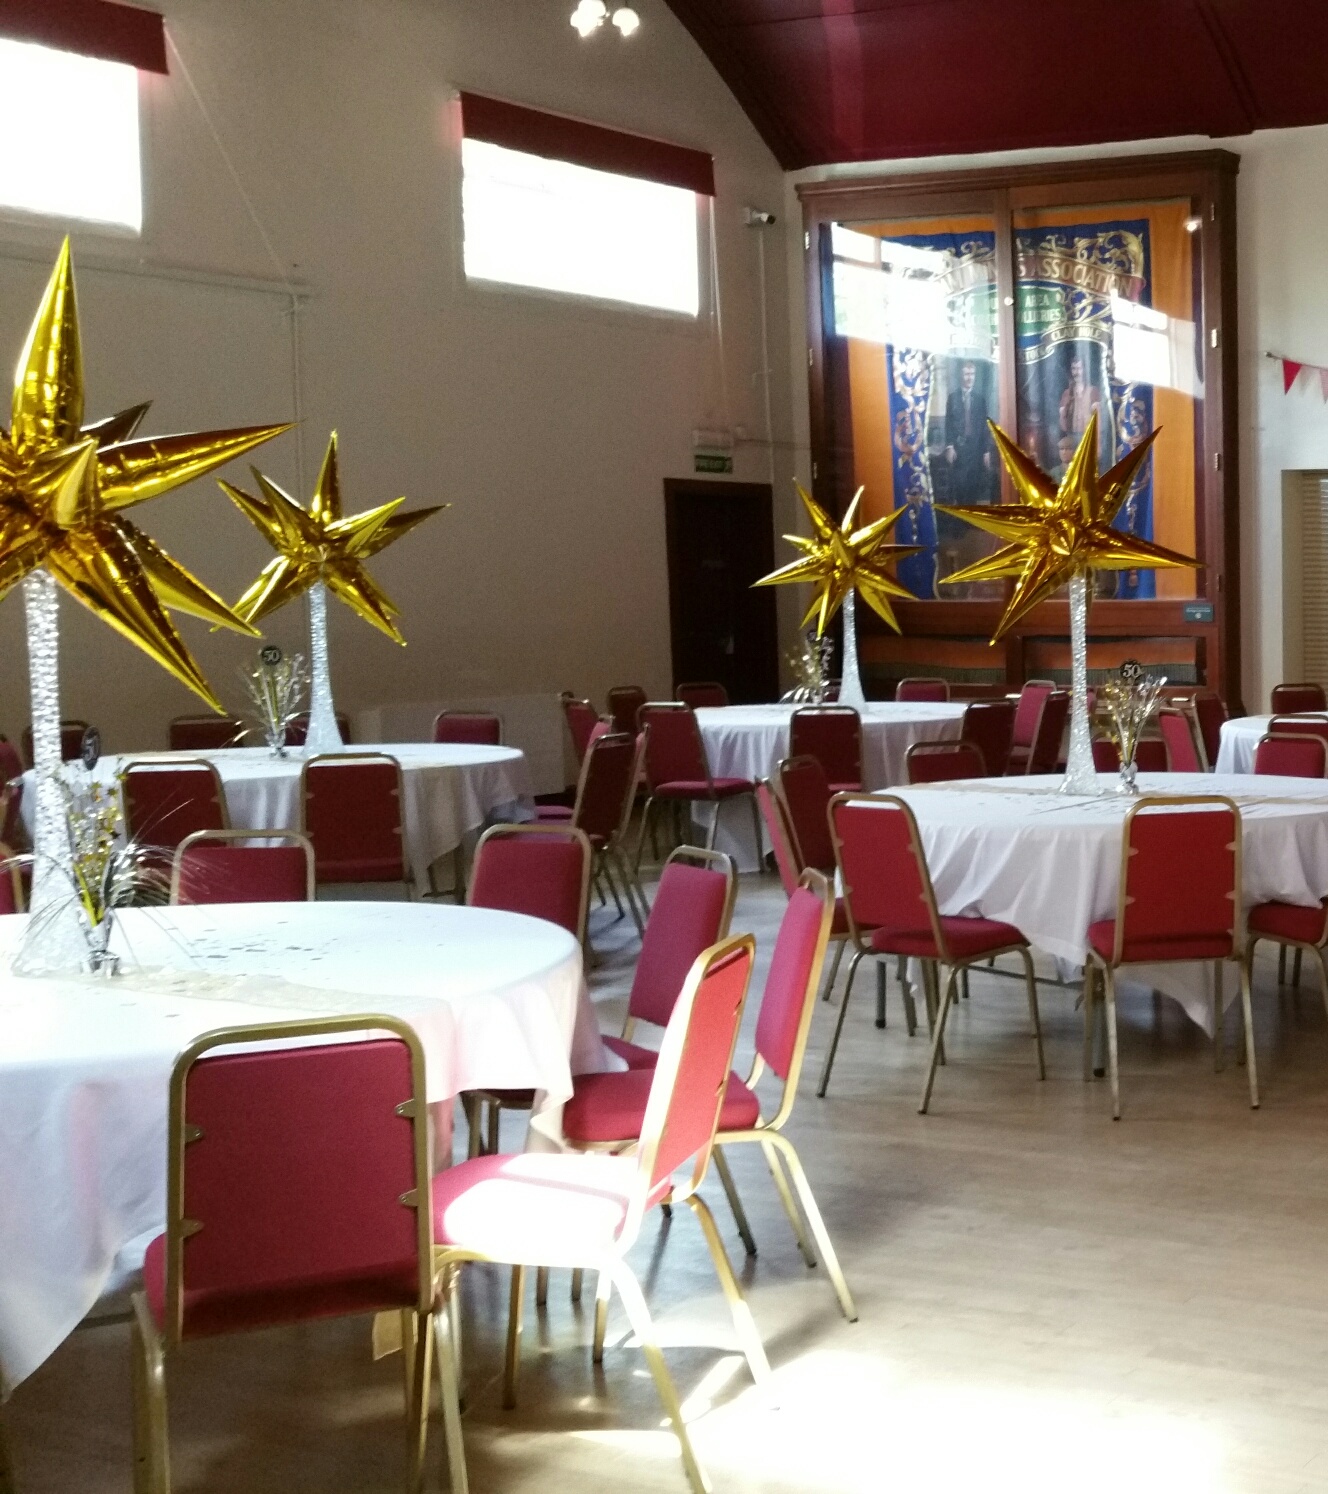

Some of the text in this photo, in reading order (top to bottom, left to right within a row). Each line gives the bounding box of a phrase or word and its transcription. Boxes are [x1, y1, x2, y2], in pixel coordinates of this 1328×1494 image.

[1030, 258, 1132, 297] ASSOCIATION
[1050, 327, 1077, 342] CLAY
[1122, 664, 1141, 679] 50
